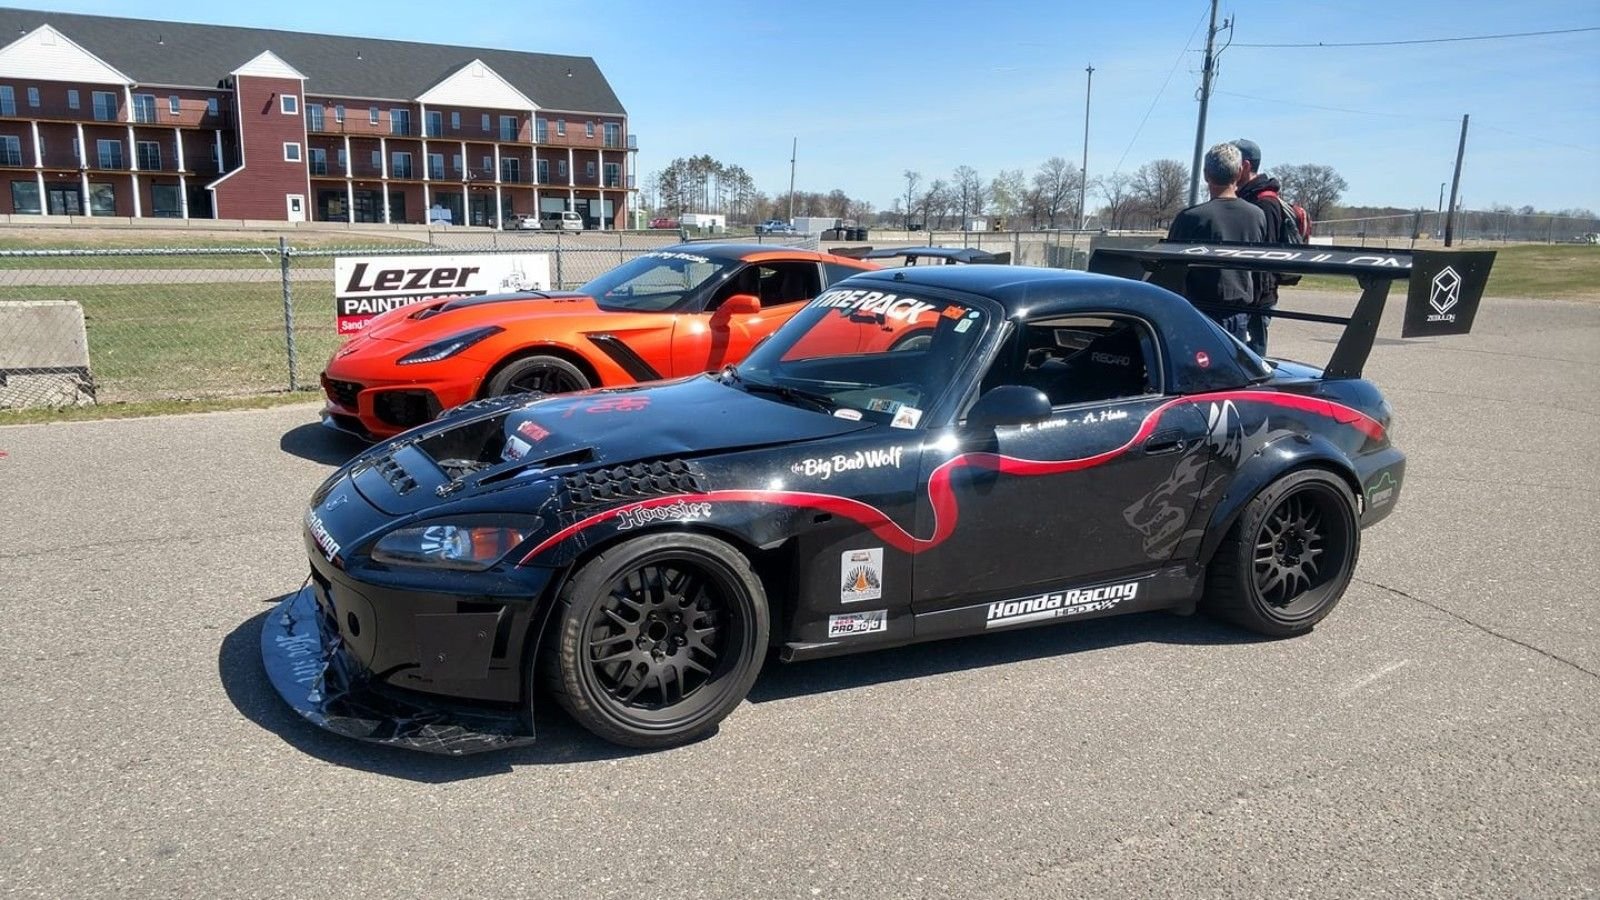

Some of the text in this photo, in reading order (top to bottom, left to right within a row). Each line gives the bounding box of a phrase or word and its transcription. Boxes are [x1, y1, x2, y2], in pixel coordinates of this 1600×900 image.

[345, 263, 480, 292] Lezer
[791, 446, 903, 480] the Big Bad Wolf
[617, 500, 712, 531] Hoosier
[987, 582, 1139, 620] Honda Racing
[831, 623, 854, 633] PRO
